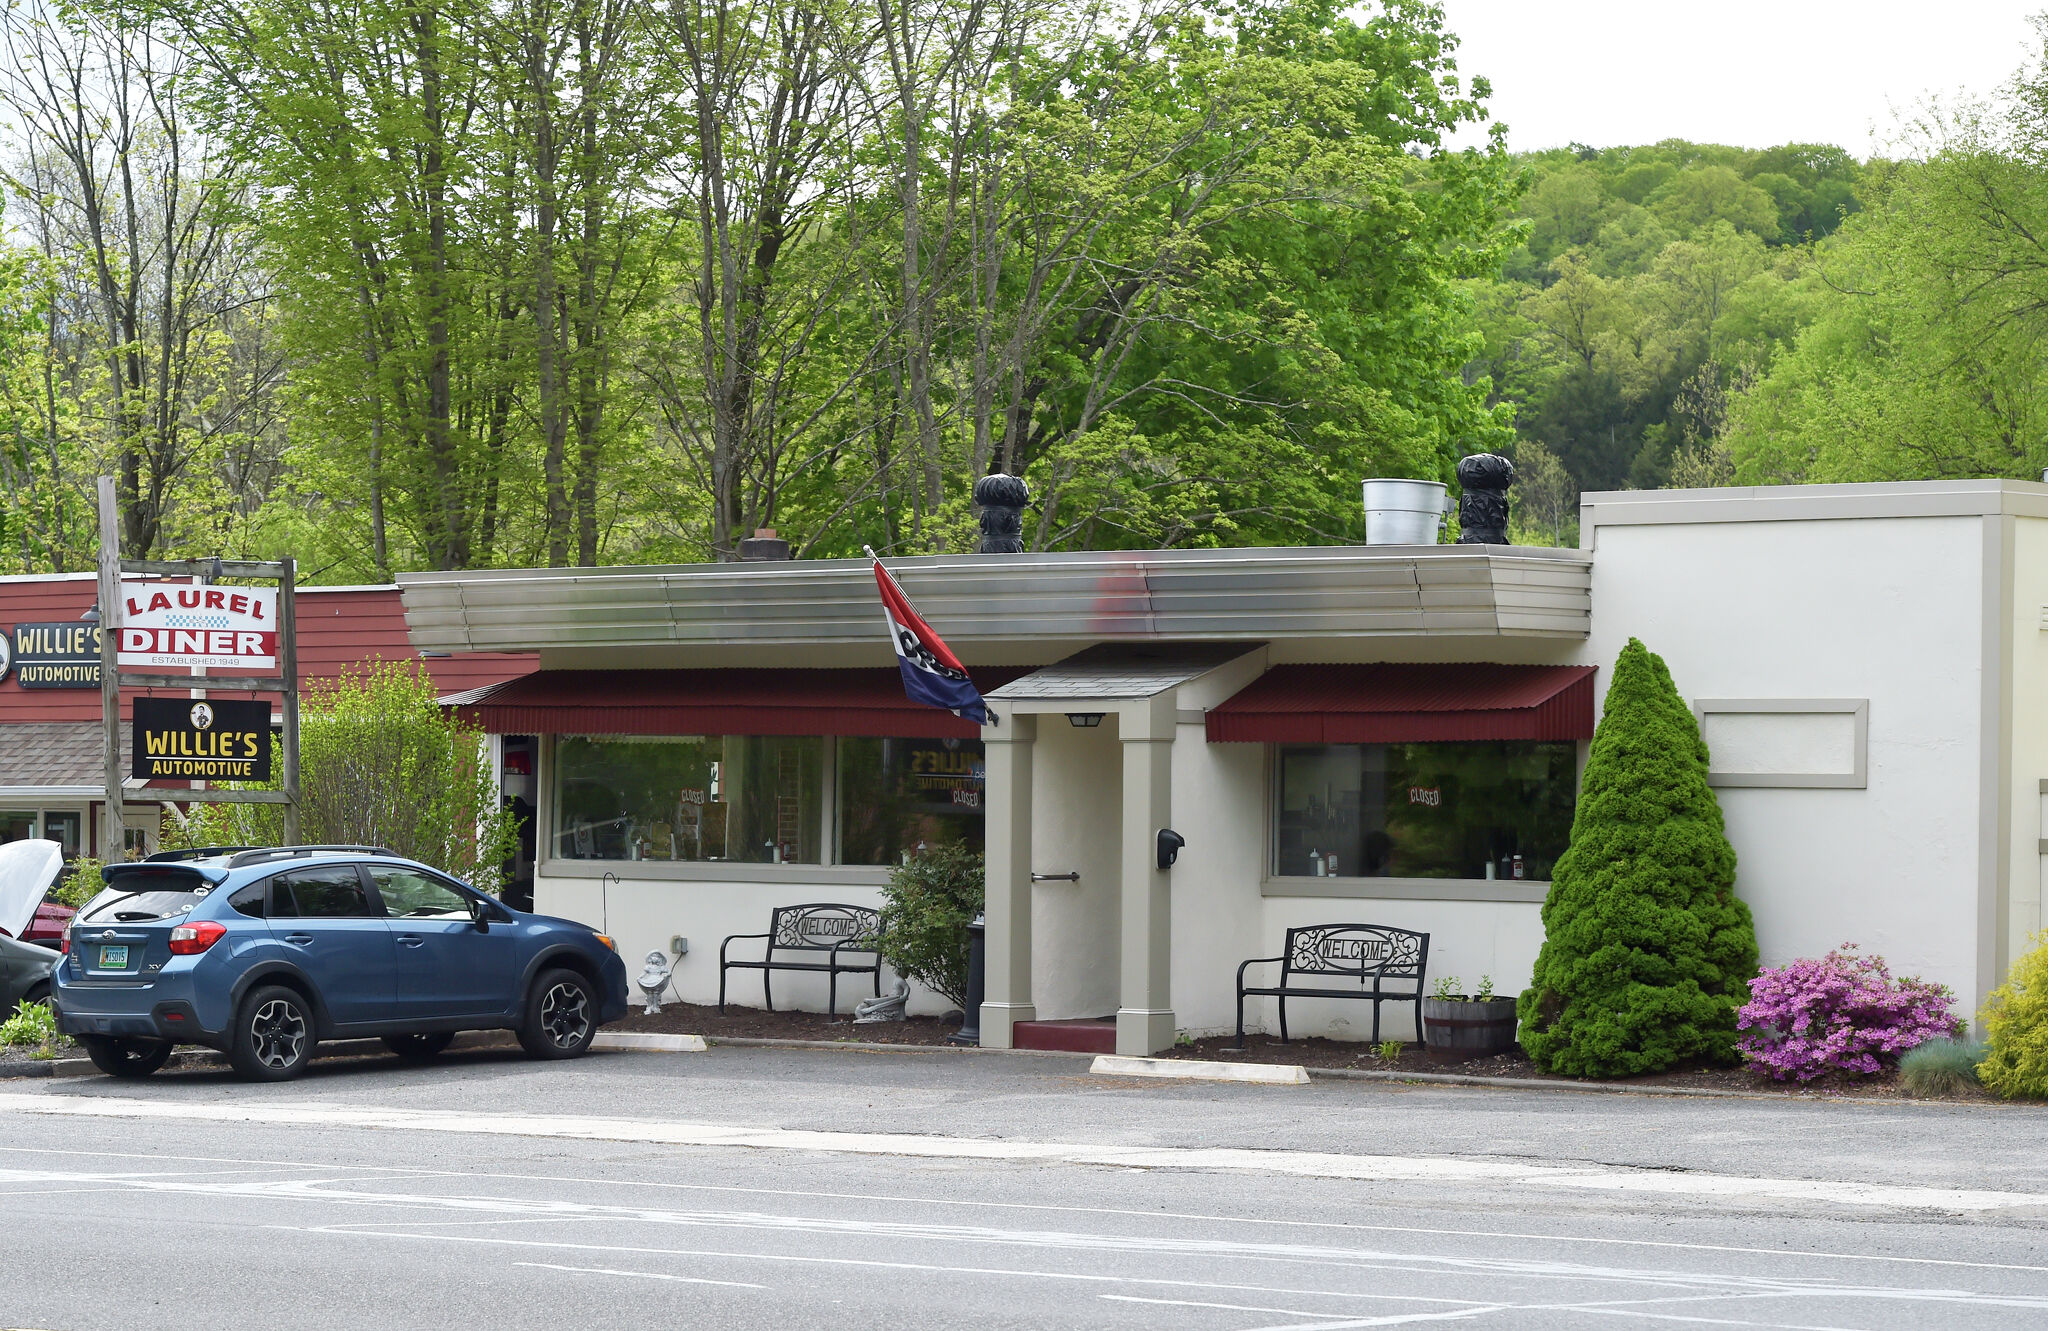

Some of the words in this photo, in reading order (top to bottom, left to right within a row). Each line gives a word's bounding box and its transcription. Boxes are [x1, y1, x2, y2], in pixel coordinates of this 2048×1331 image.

[126, 590, 264, 620] LAUREL
[17, 627, 101, 654] WILLIE'S
[122, 630, 265, 655] DINER
[151, 656, 216, 665] ESTABLISHED
[217, 658, 240, 666] 1949
[20, 666, 100, 682] AUTOMOTIVE
[145, 730, 258, 757] WILLIE'S
[152, 760, 251, 776] AUTOMOTIVE
[681, 789, 705, 805] CLOSED
[953, 790, 979, 807] CLOSED
[1410, 788, 1439, 806] CLOSED
[800, 918, 856, 936] WELCOME
[1322, 939, 1389, 960] WELCOME
